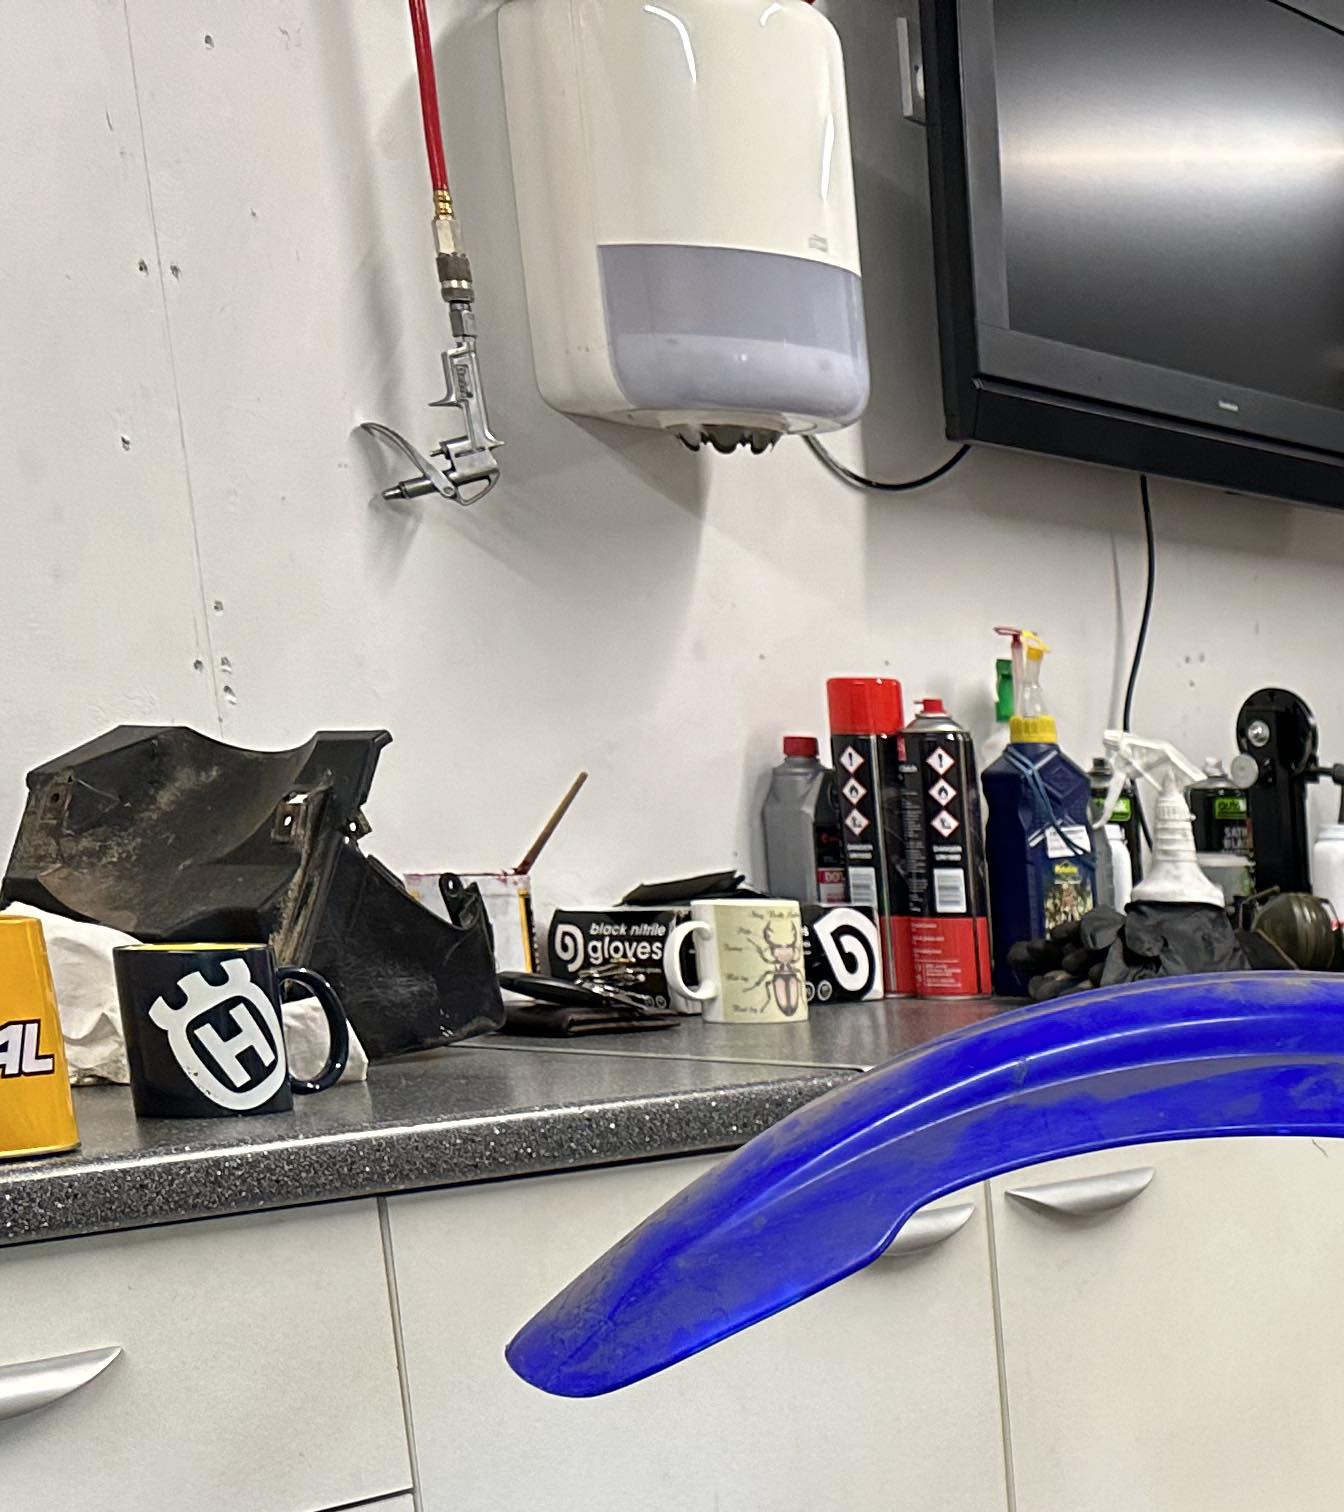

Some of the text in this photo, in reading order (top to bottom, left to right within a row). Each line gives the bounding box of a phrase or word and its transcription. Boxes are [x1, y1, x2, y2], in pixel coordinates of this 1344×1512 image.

[589, 922, 667, 937] black nitrile
[587, 936, 663, 965] gloves
[194, 1002, 276, 1088] H
